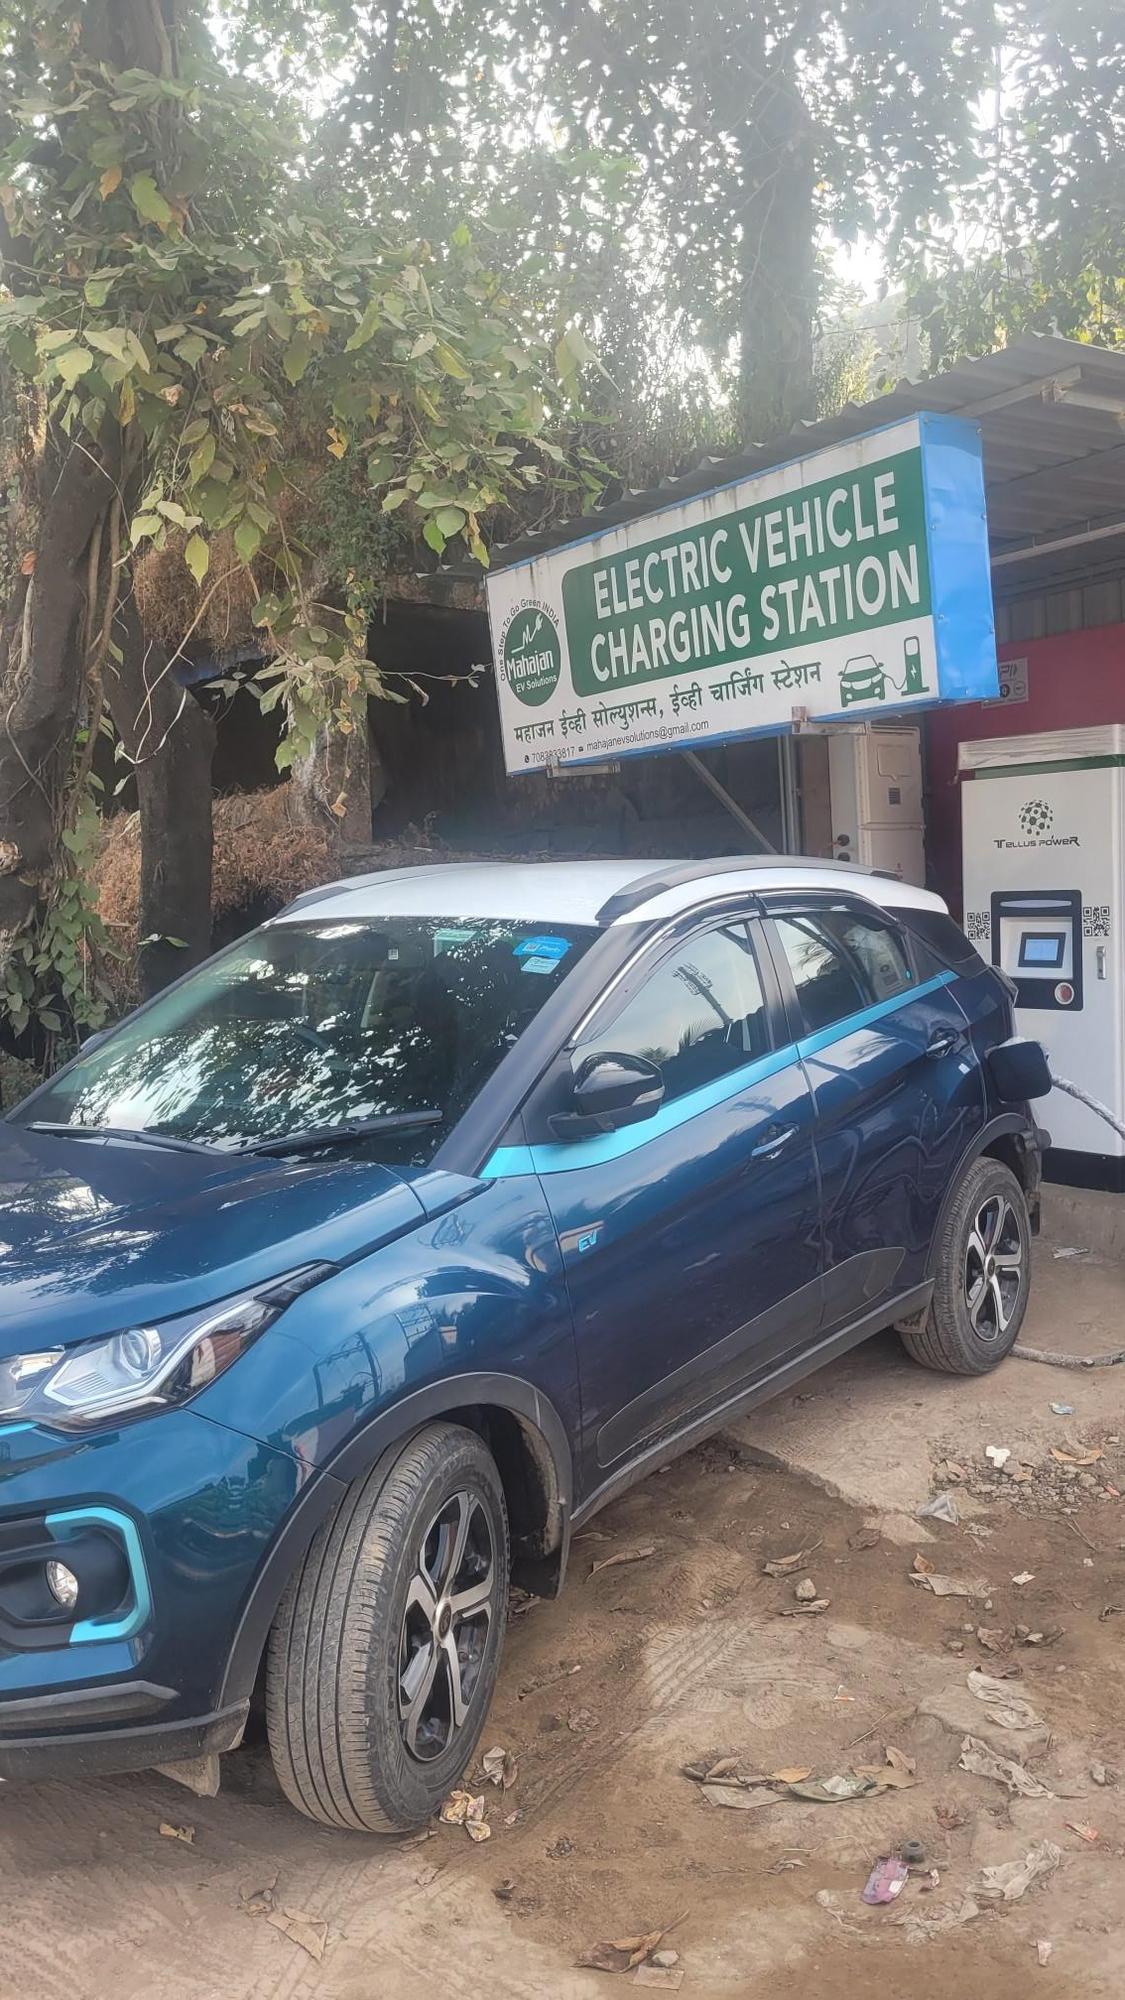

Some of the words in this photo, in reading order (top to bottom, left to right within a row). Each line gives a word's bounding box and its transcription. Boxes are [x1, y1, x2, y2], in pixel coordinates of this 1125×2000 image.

[593, 528, 733, 620] ELECTRIC
[738, 470, 900, 574] VEHICLE
[510, 605, 520, 617] Go
[520, 599, 541, 608] Green
[542, 601, 560, 628] INDIA
[590, 593, 751, 682] CHARGING
[760, 544, 921, 641] STATION
[502, 617, 511, 628] To
[497, 631, 506, 656] Step
[498, 660, 506, 682] One
[506, 650, 554, 681] Mahajan
[515, 681, 525, 693] EV
[526, 674, 557, 690] Solutions
[513, 719, 555, 744] महाजन
[559, 708, 587, 740] ईव्ही
[669, 682, 703, 716] ईव्ही
[708, 667, 764, 702] चार्जिंग
[771, 659, 822, 691] स्टेशन
[586, 719, 709, 752] mahajanevsolutions@gmail.com
[579, 1230, 597, 1252] EV
